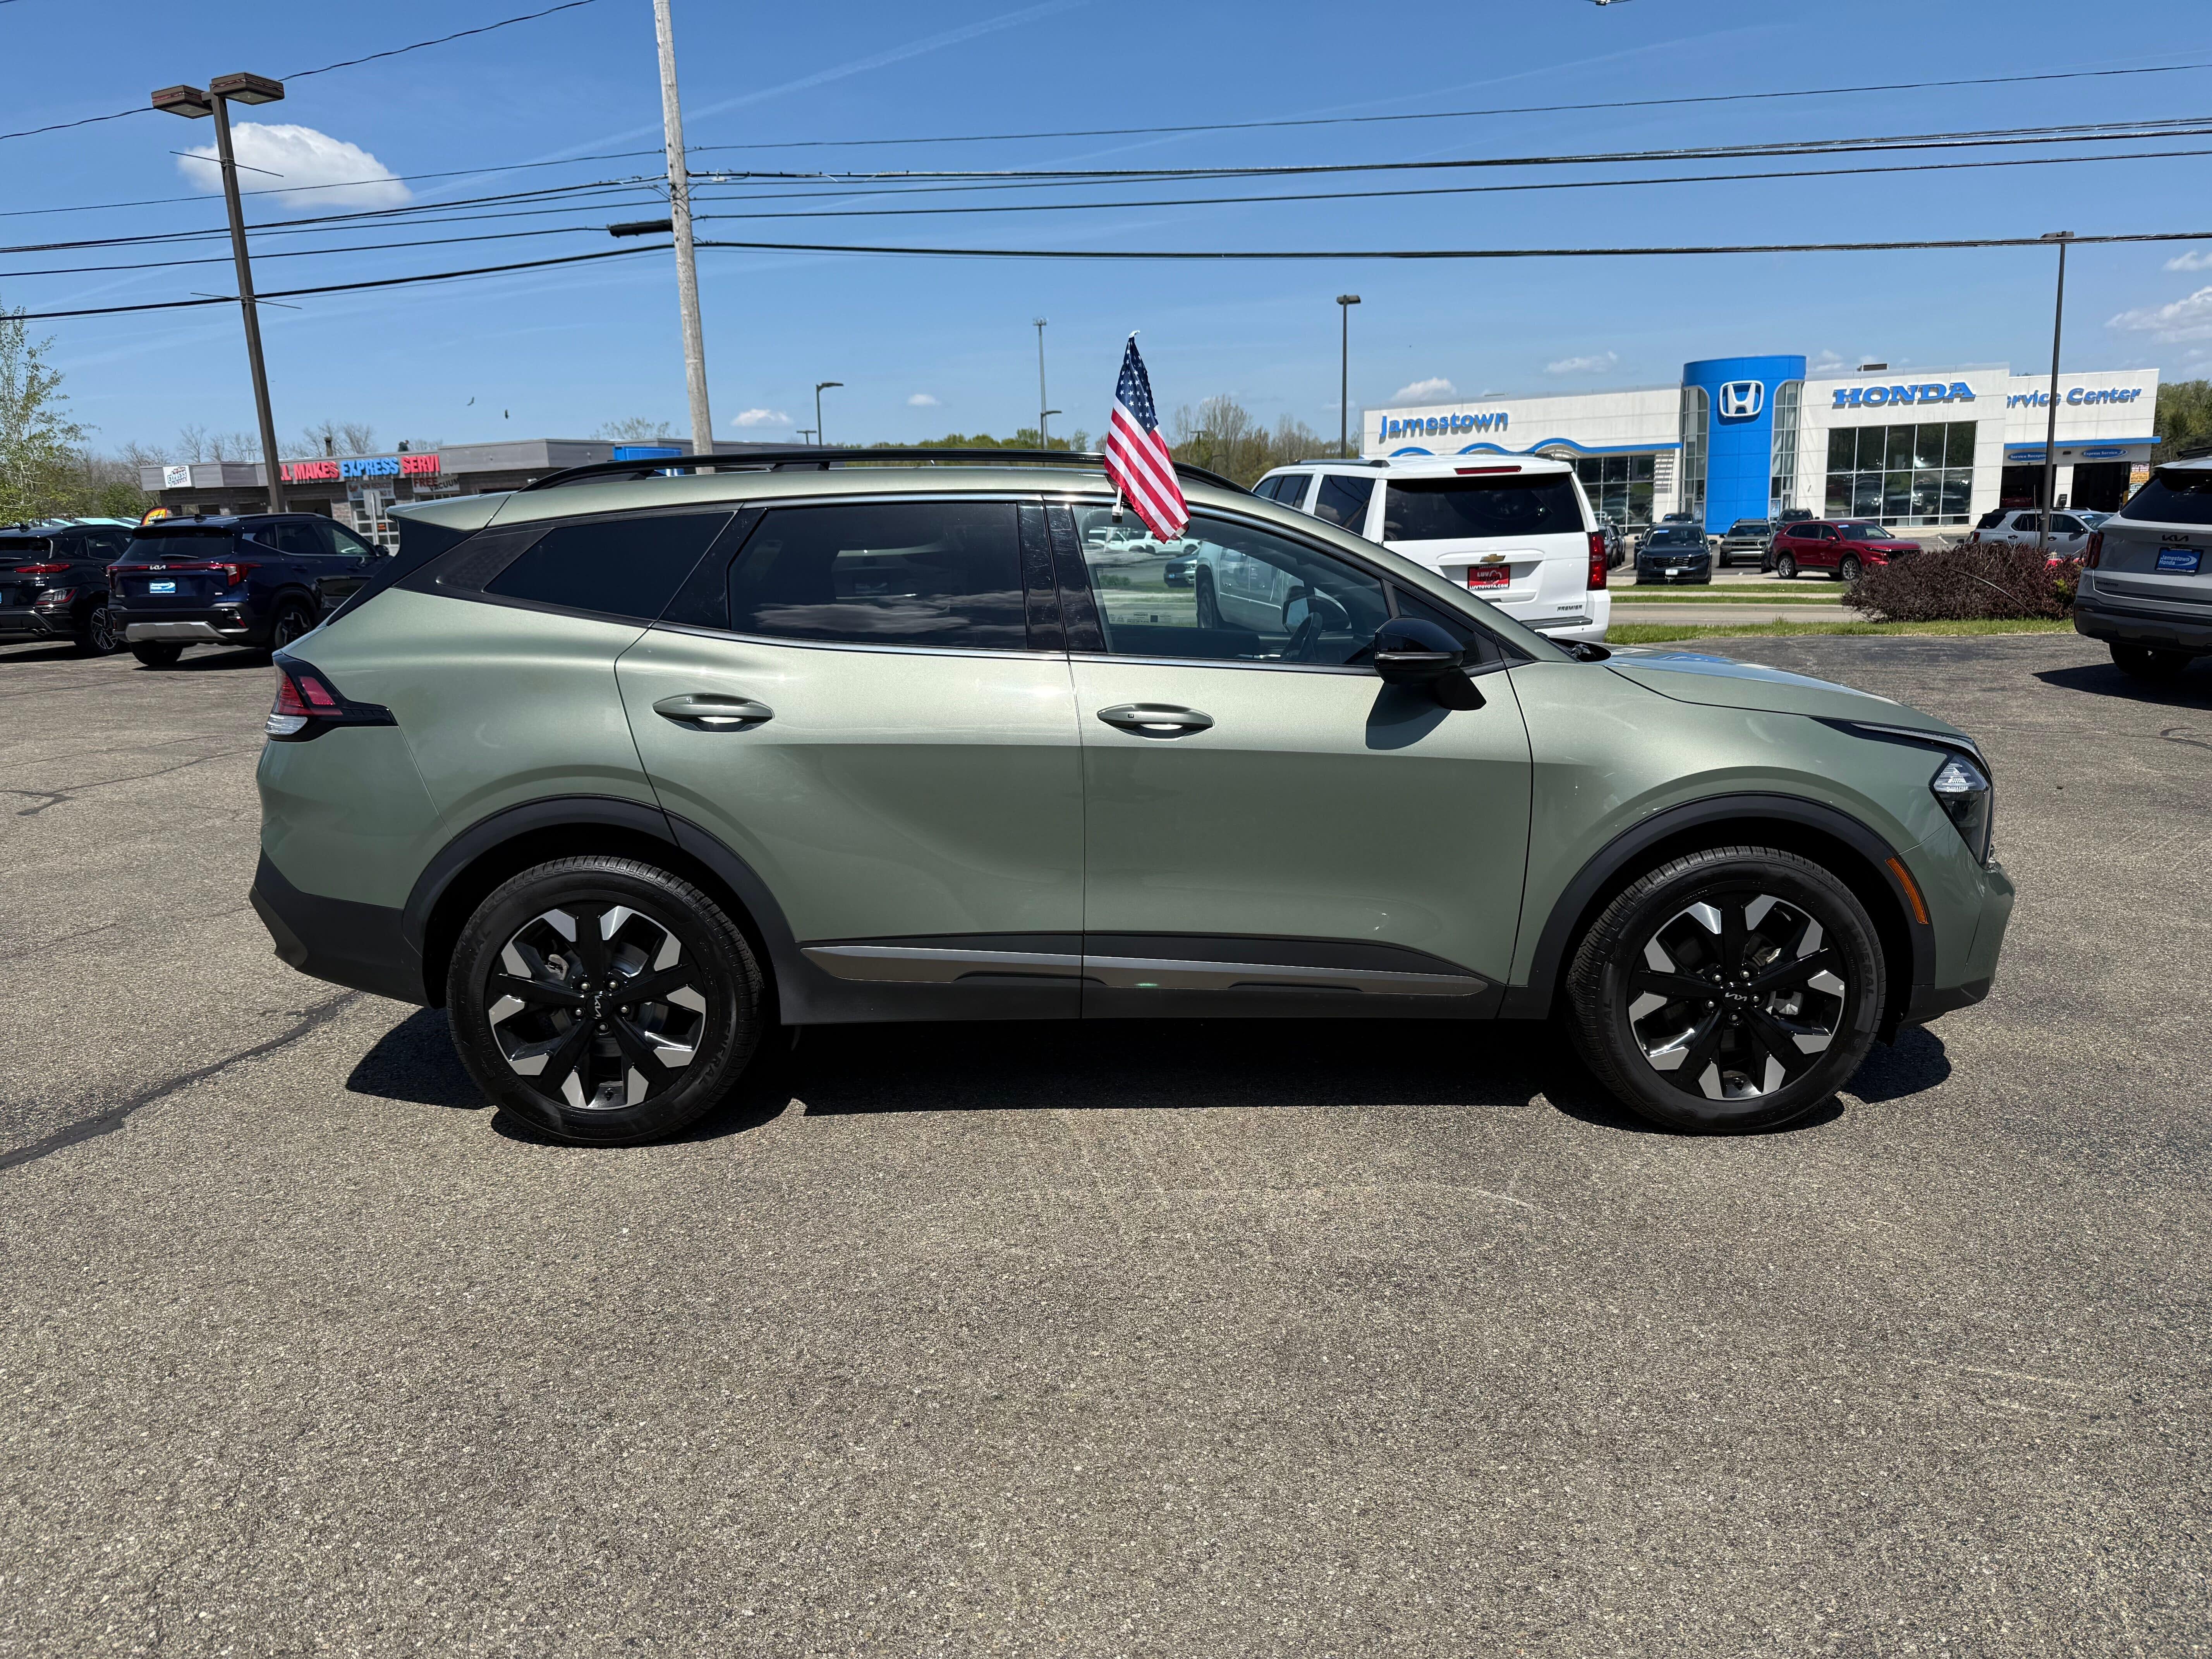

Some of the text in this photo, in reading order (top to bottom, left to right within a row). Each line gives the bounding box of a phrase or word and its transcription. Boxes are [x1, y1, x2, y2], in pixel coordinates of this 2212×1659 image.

[1832, 382, 1976, 406] HONDA
[2067, 387, 2142, 404] Center
[1379, 412, 1508, 437] Jamestown
[294, 461, 339, 480] MAKES
[341, 457, 399, 477] EXPRESS
[413, 477, 438, 488] FREE
[698, 1010, 732, 1085] ENERAL
